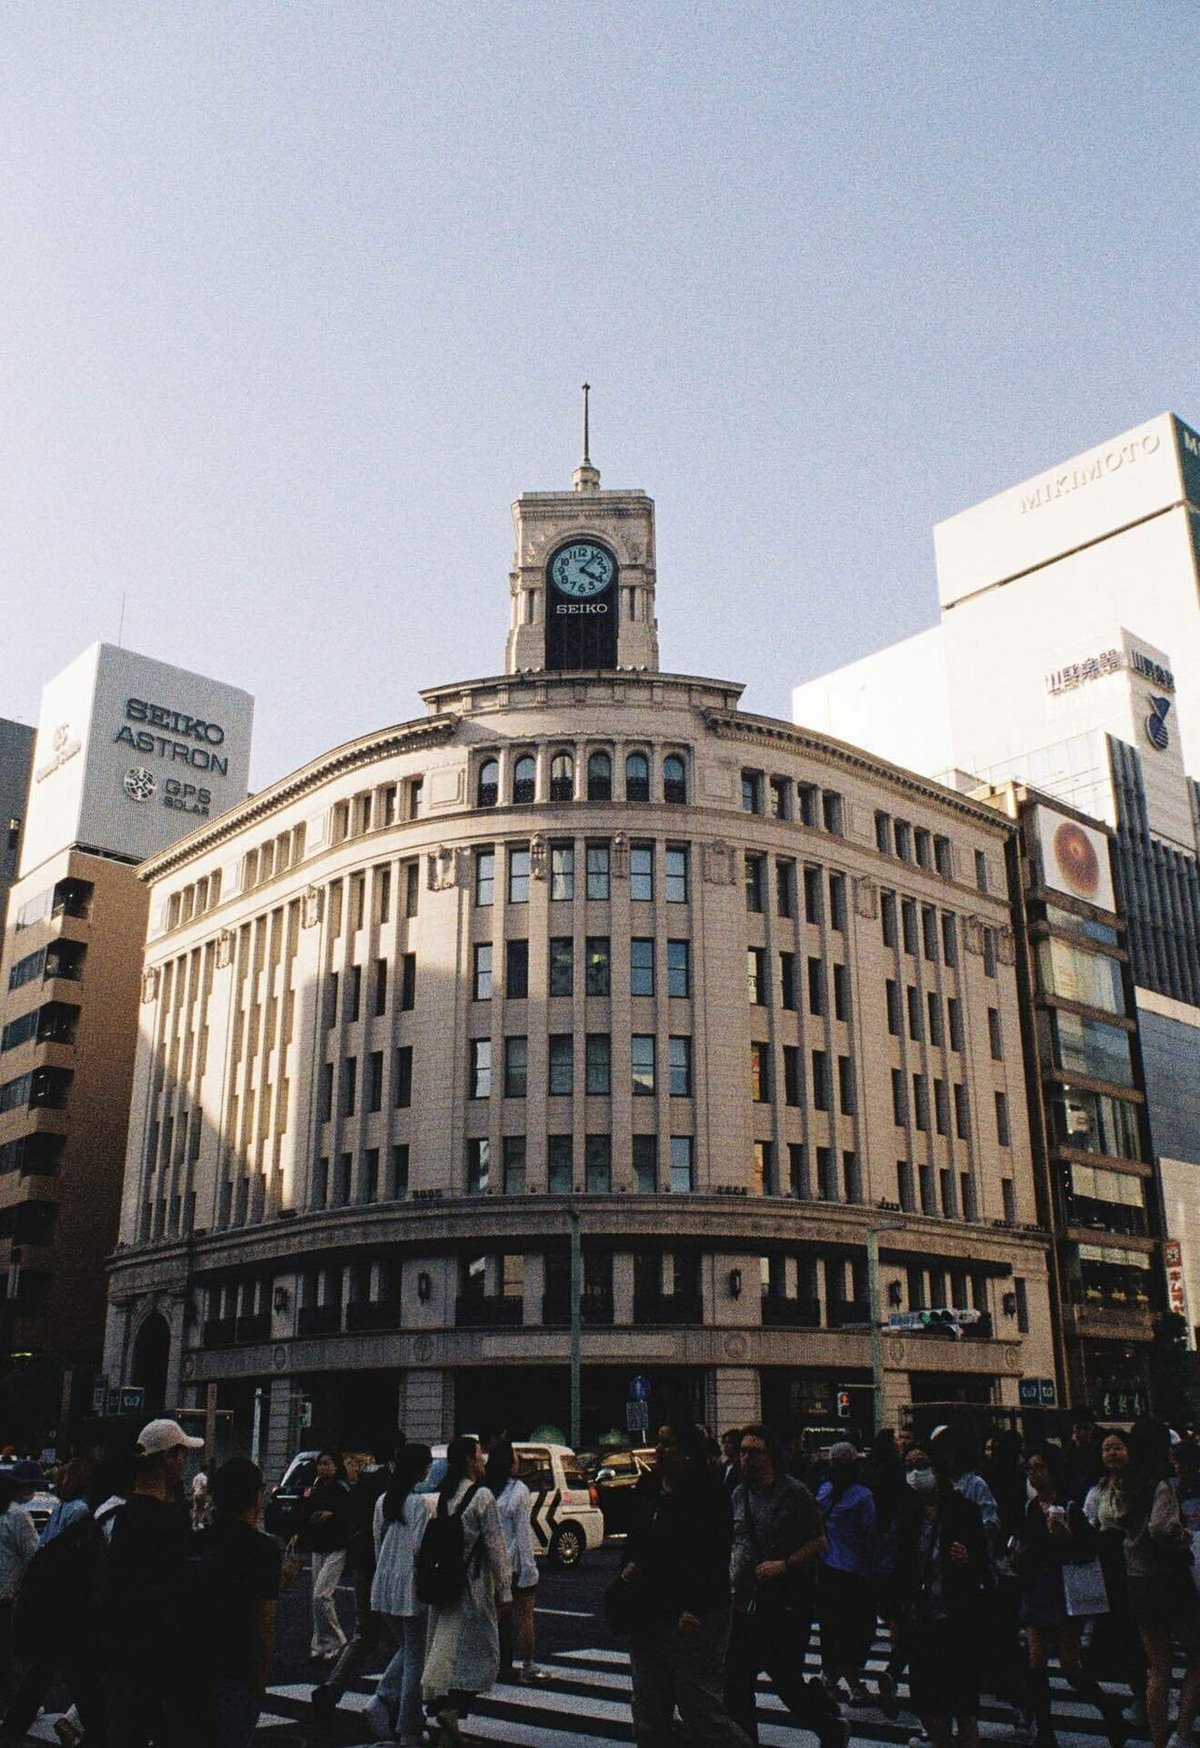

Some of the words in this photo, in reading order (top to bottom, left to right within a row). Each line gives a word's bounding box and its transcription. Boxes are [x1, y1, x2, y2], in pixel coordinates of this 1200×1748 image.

[1019, 433, 1161, 514] MIKIMOTO
[569, 551, 576, 559] 11
[578, 548, 588, 557] 12
[561, 558, 569, 566] 10
[597, 556, 604, 565] 2
[558, 566, 565, 576] 9
[600, 565, 607, 575] 3
[561, 575, 569, 584] 8
[570, 581, 577, 590] 7
[578, 583, 586, 592] 6
[588, 581, 595, 590] 5
[556, 604, 608, 614] SEIKO
[1045, 649, 1123, 695] 山野楽器
[125, 697, 225, 746] SEIKO
[113, 726, 229, 776] ASTRON
[165, 778, 212, 805] GPS
[163, 796, 210, 816] SOLAR
